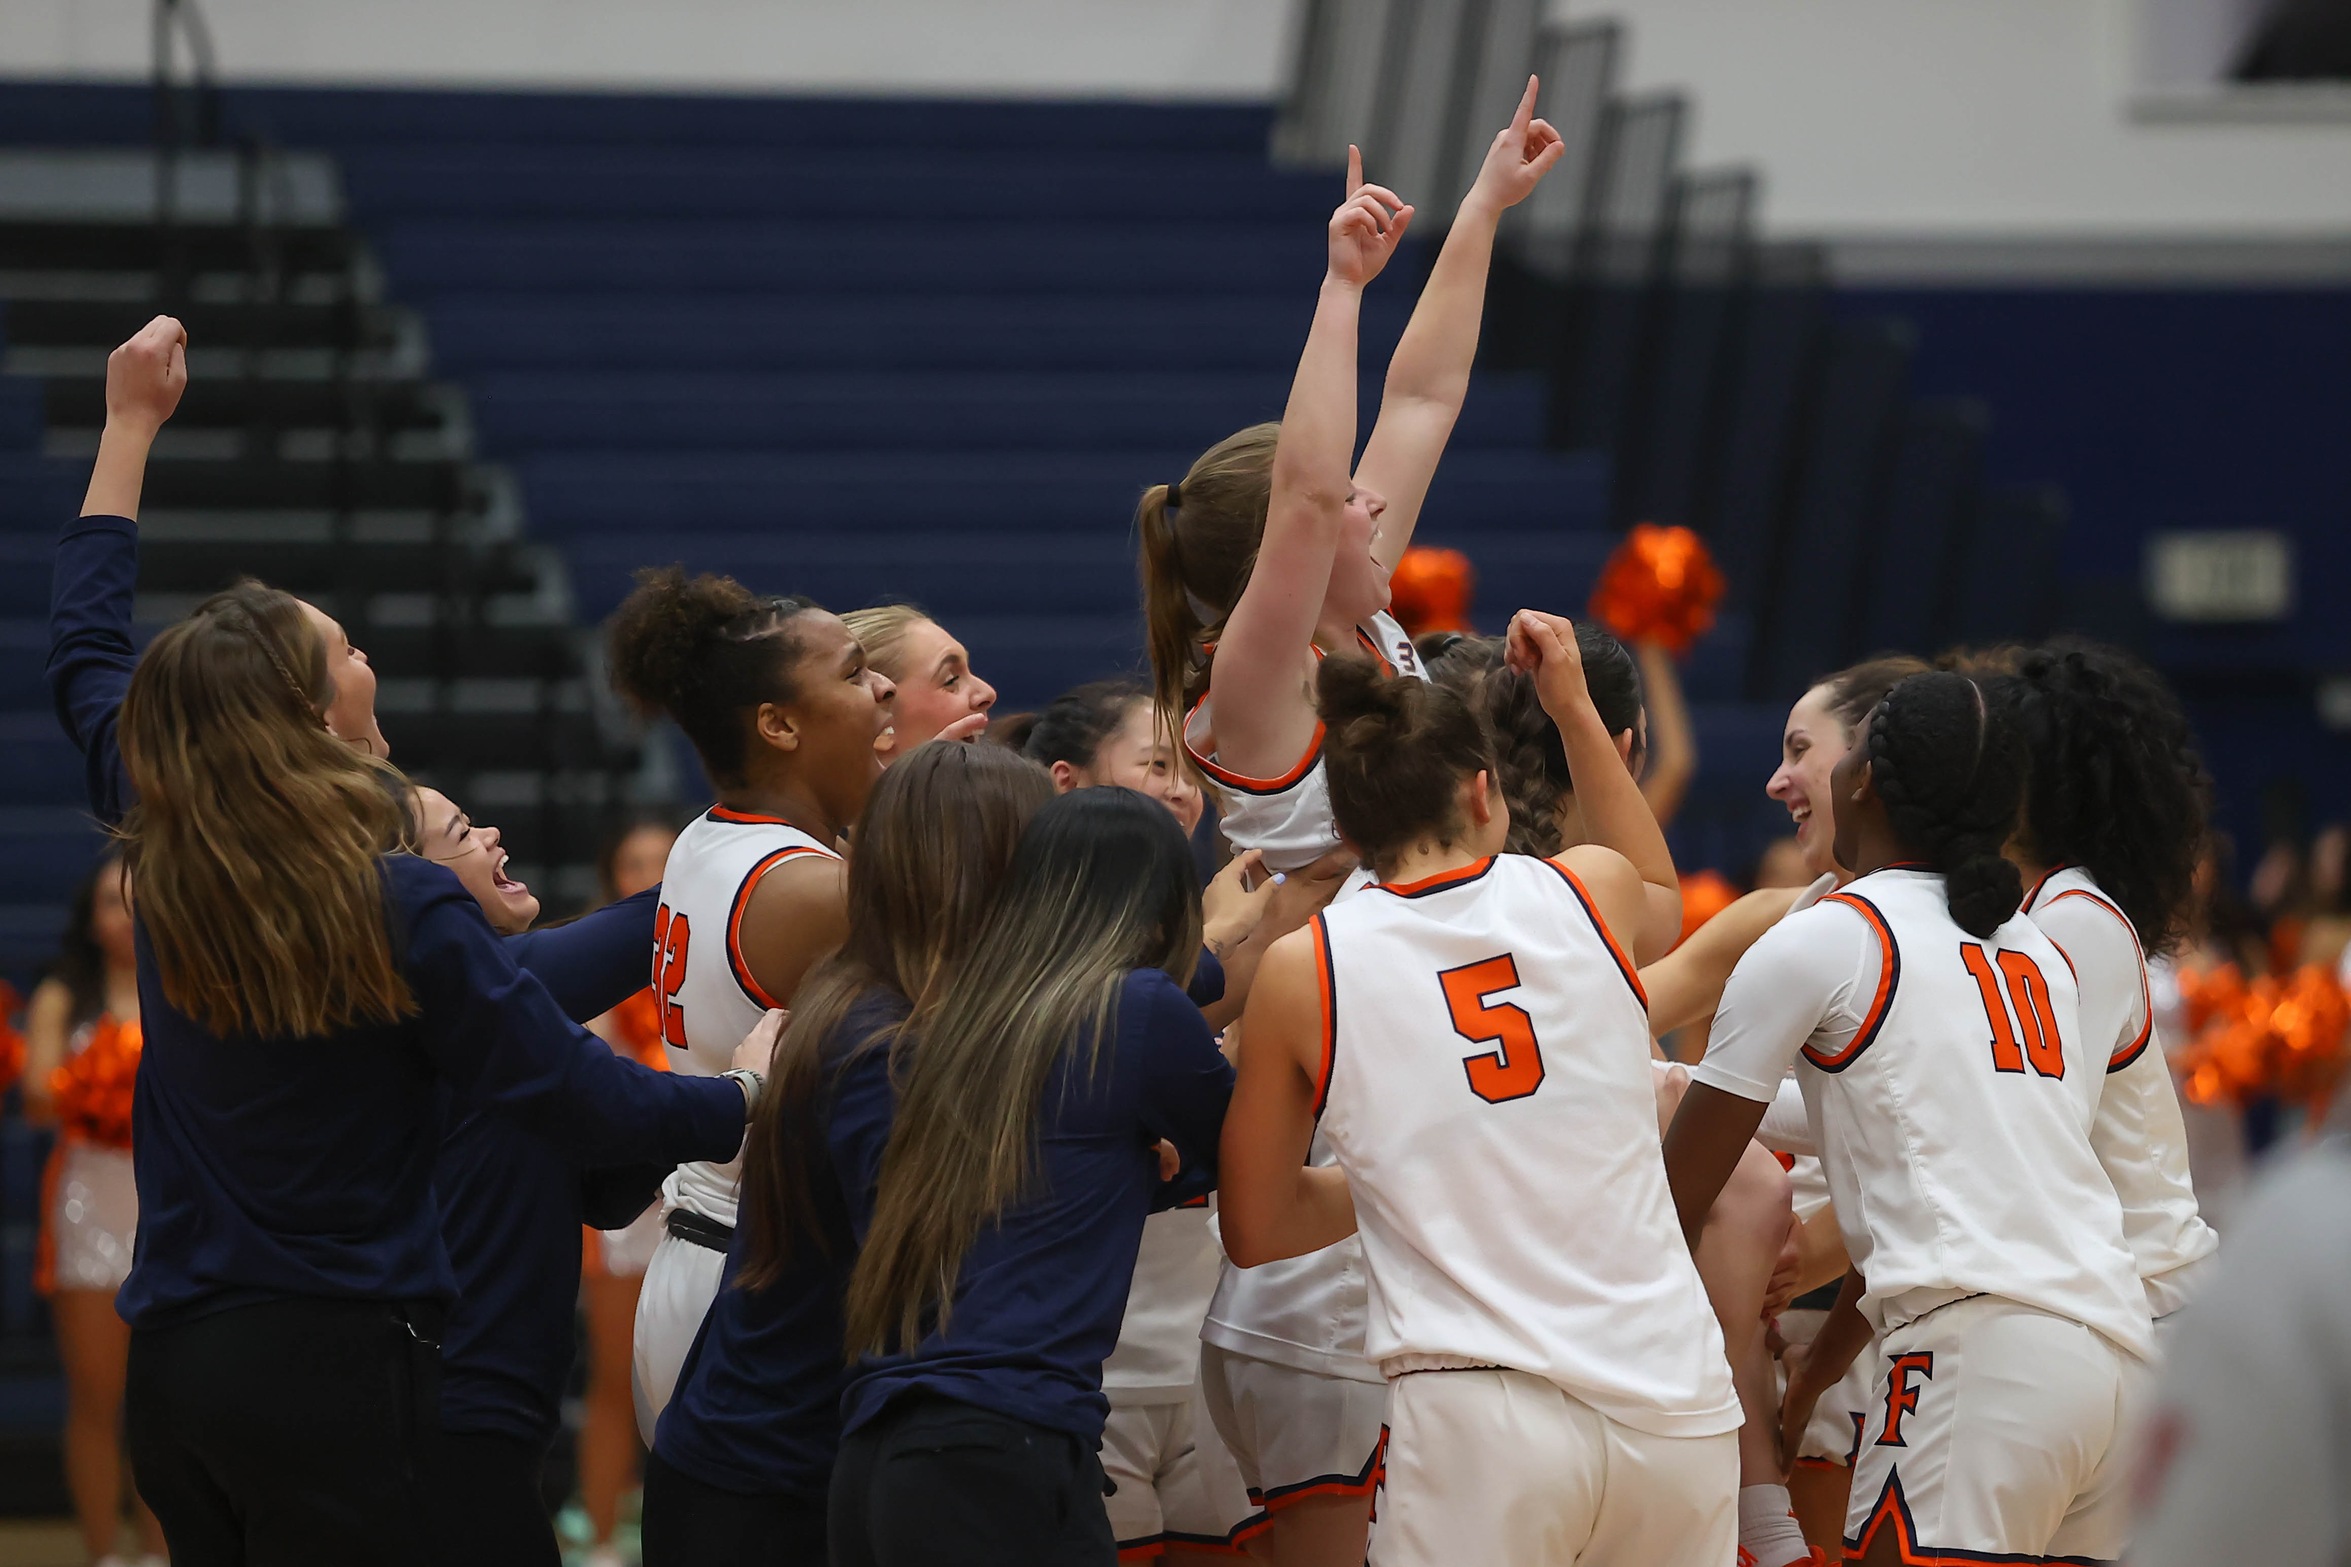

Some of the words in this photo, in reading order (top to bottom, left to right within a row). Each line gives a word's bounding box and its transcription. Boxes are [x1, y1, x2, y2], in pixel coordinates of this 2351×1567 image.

[1396, 641, 1416, 673] 3
[1436, 952, 1546, 1105] 5
[1960, 941, 2065, 1082] 10
[1874, 1351, 1934, 1447] F
